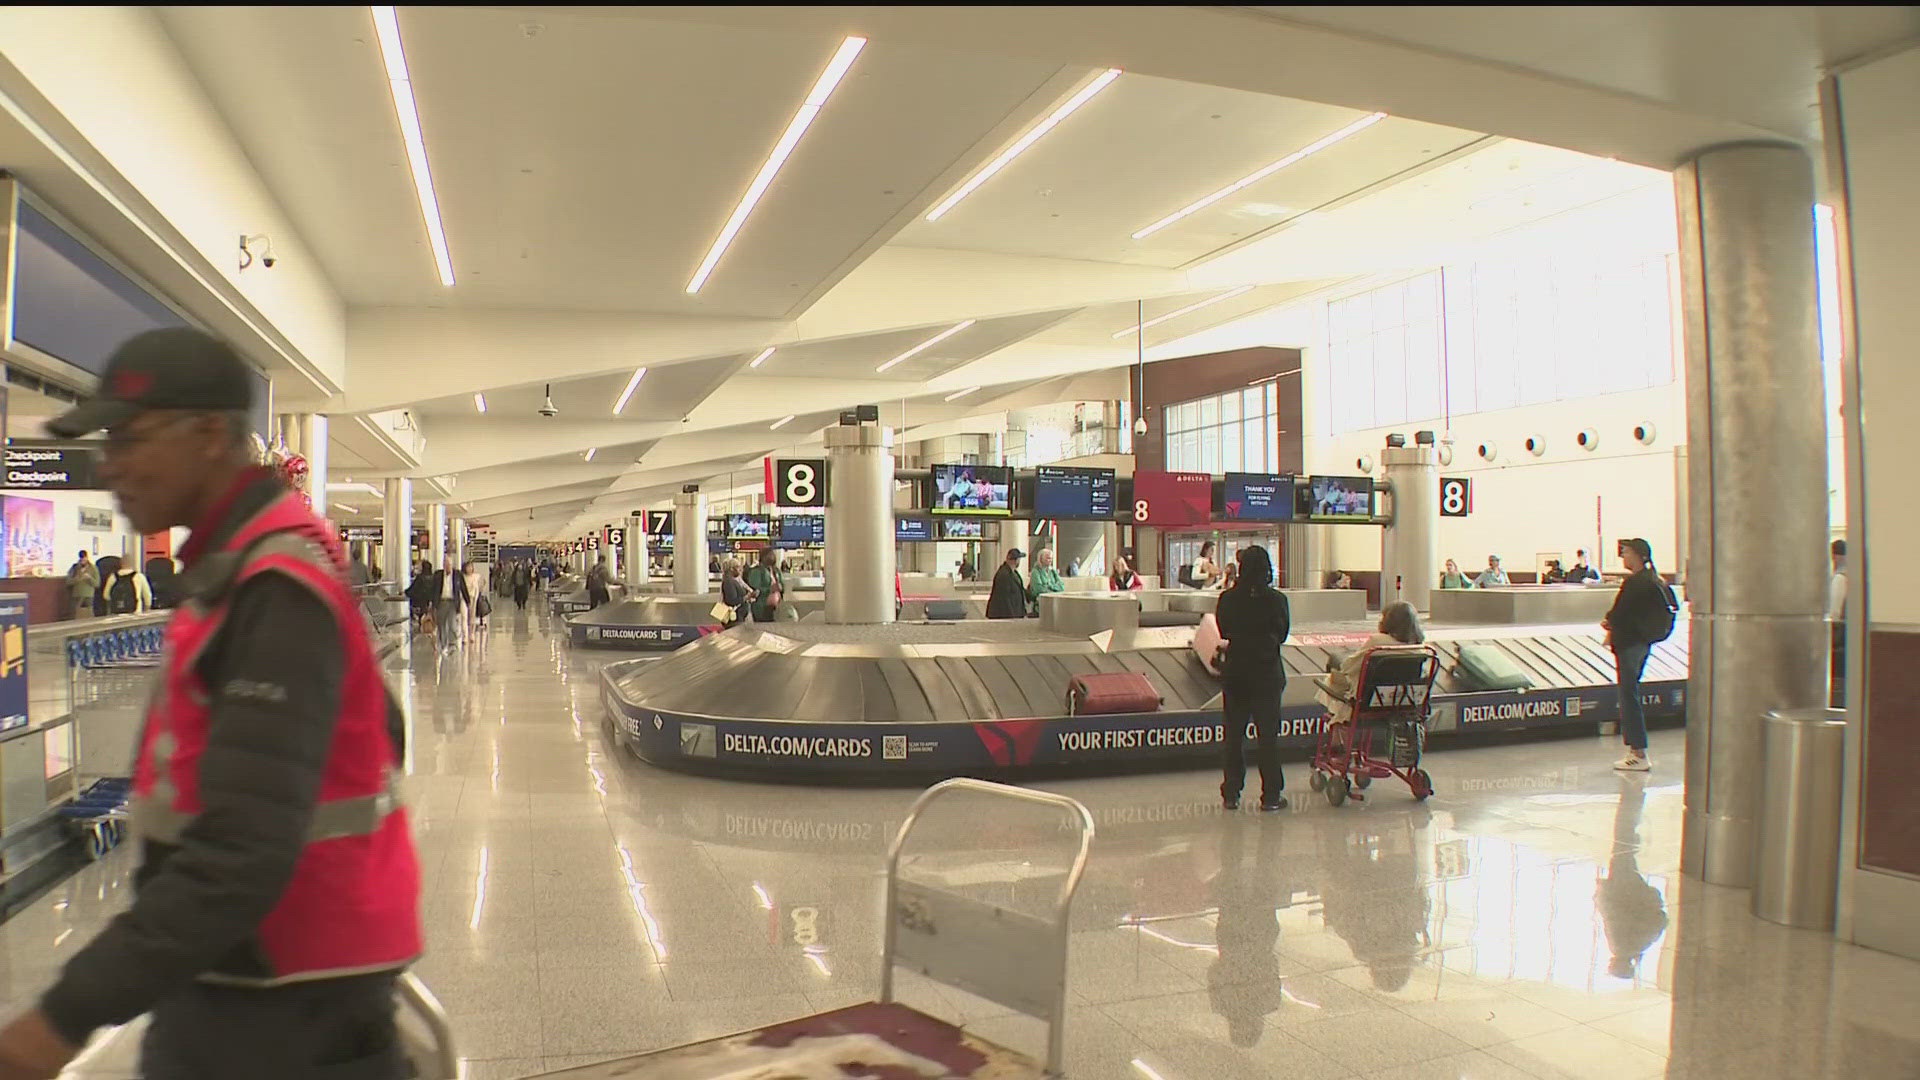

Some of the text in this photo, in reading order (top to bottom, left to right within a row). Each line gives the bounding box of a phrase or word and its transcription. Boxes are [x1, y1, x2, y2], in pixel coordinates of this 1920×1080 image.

[8, 471, 69, 482] Checkpoint
[786, 463, 816, 503] 8
[1244, 485, 1263, 493] THANK
[1443, 481, 1464, 514] 8
[1135, 500, 1149, 521] 8
[653, 513, 668, 533] 7
[588, 538, 597, 550] 5
[610, 530, 621, 544] 6
[575, 543, 583, 552] 4
[602, 629, 658, 640] DELTA.COM/CARDS
[1463, 700, 1560, 723] DELTA.COM/CARDS
[724, 733, 872, 758] DELTA.COM/CARDS
[1058, 731, 1102, 751] YOUR
[1103, 729, 1145, 749] FIRST
[1147, 725, 1213, 746] CHECKED
